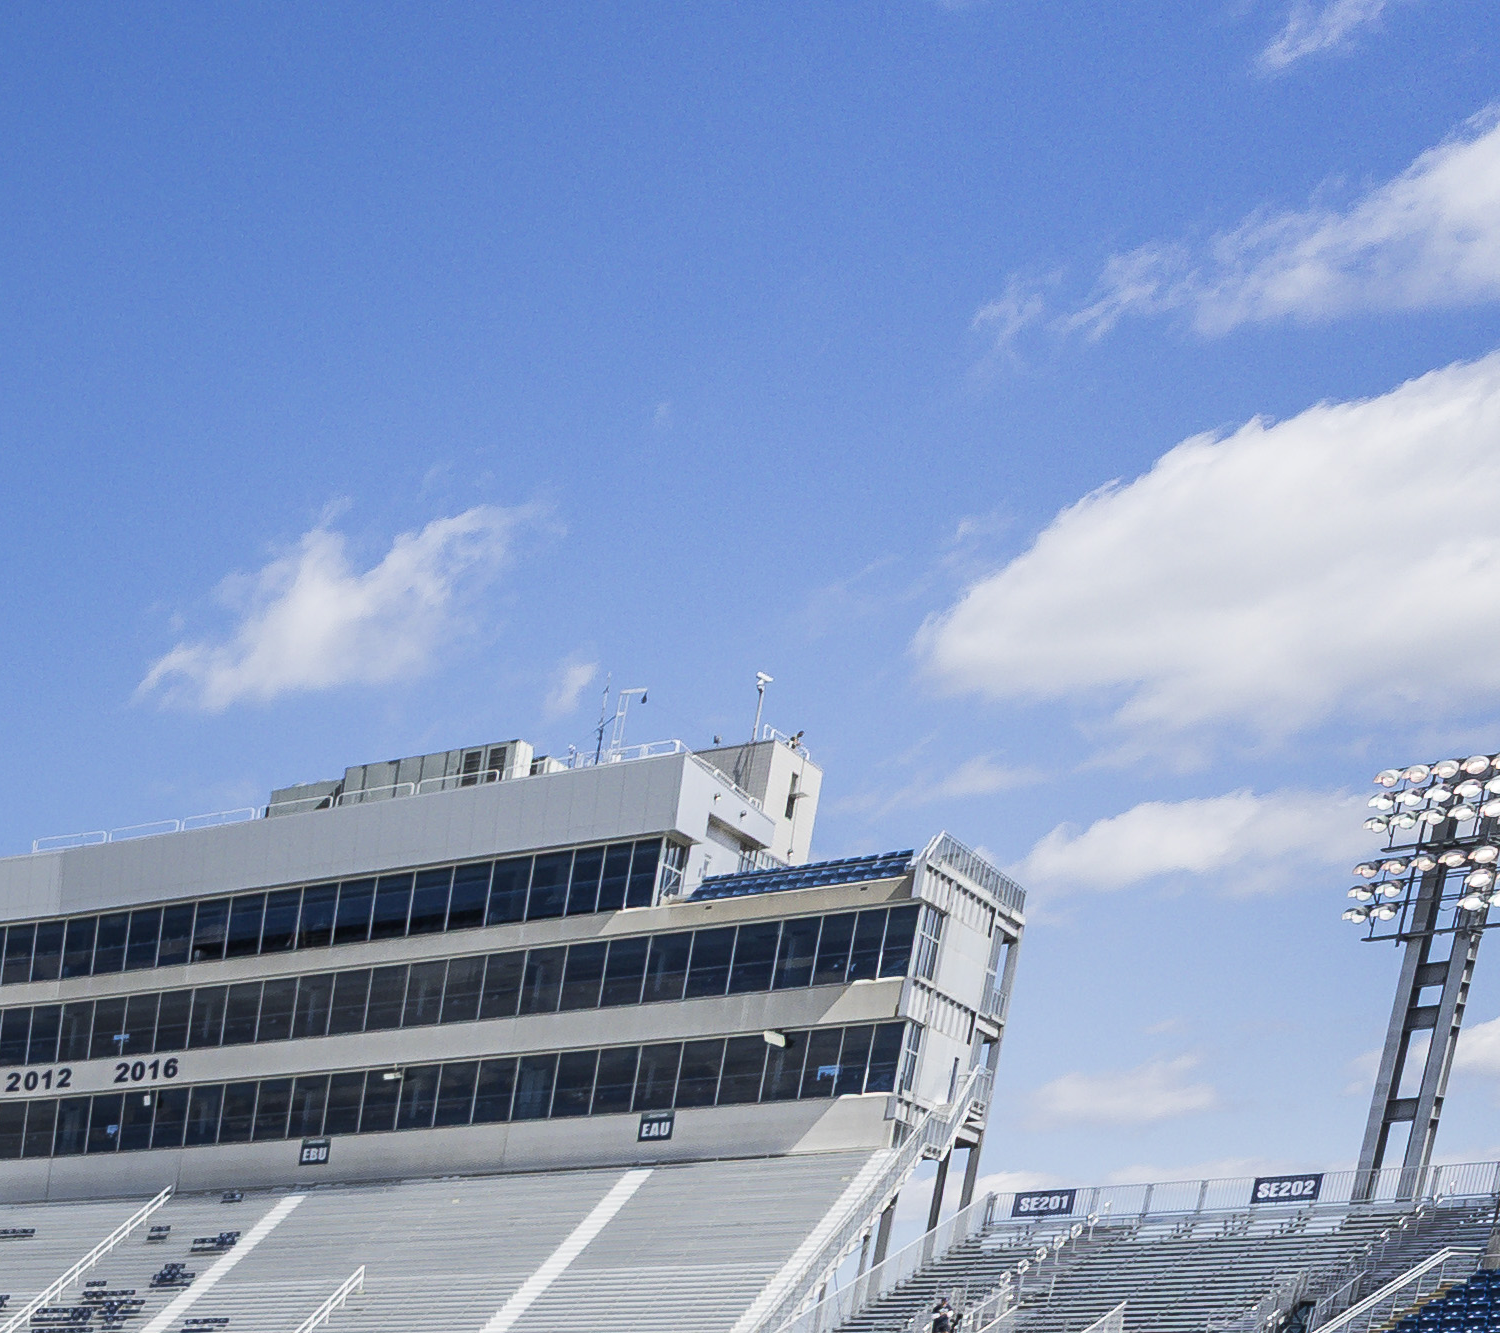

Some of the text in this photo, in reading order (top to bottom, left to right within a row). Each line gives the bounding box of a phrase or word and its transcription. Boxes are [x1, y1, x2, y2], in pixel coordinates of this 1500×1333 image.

[4, 1069, 72, 1092] 2012
[113, 1058, 179, 1083] 2016
[641, 1121, 670, 1137] EAU
[302, 1147, 328, 1161] EBU
[1256, 1180, 1316, 1198] SE202
[1020, 1195, 1069, 1212] SE201
